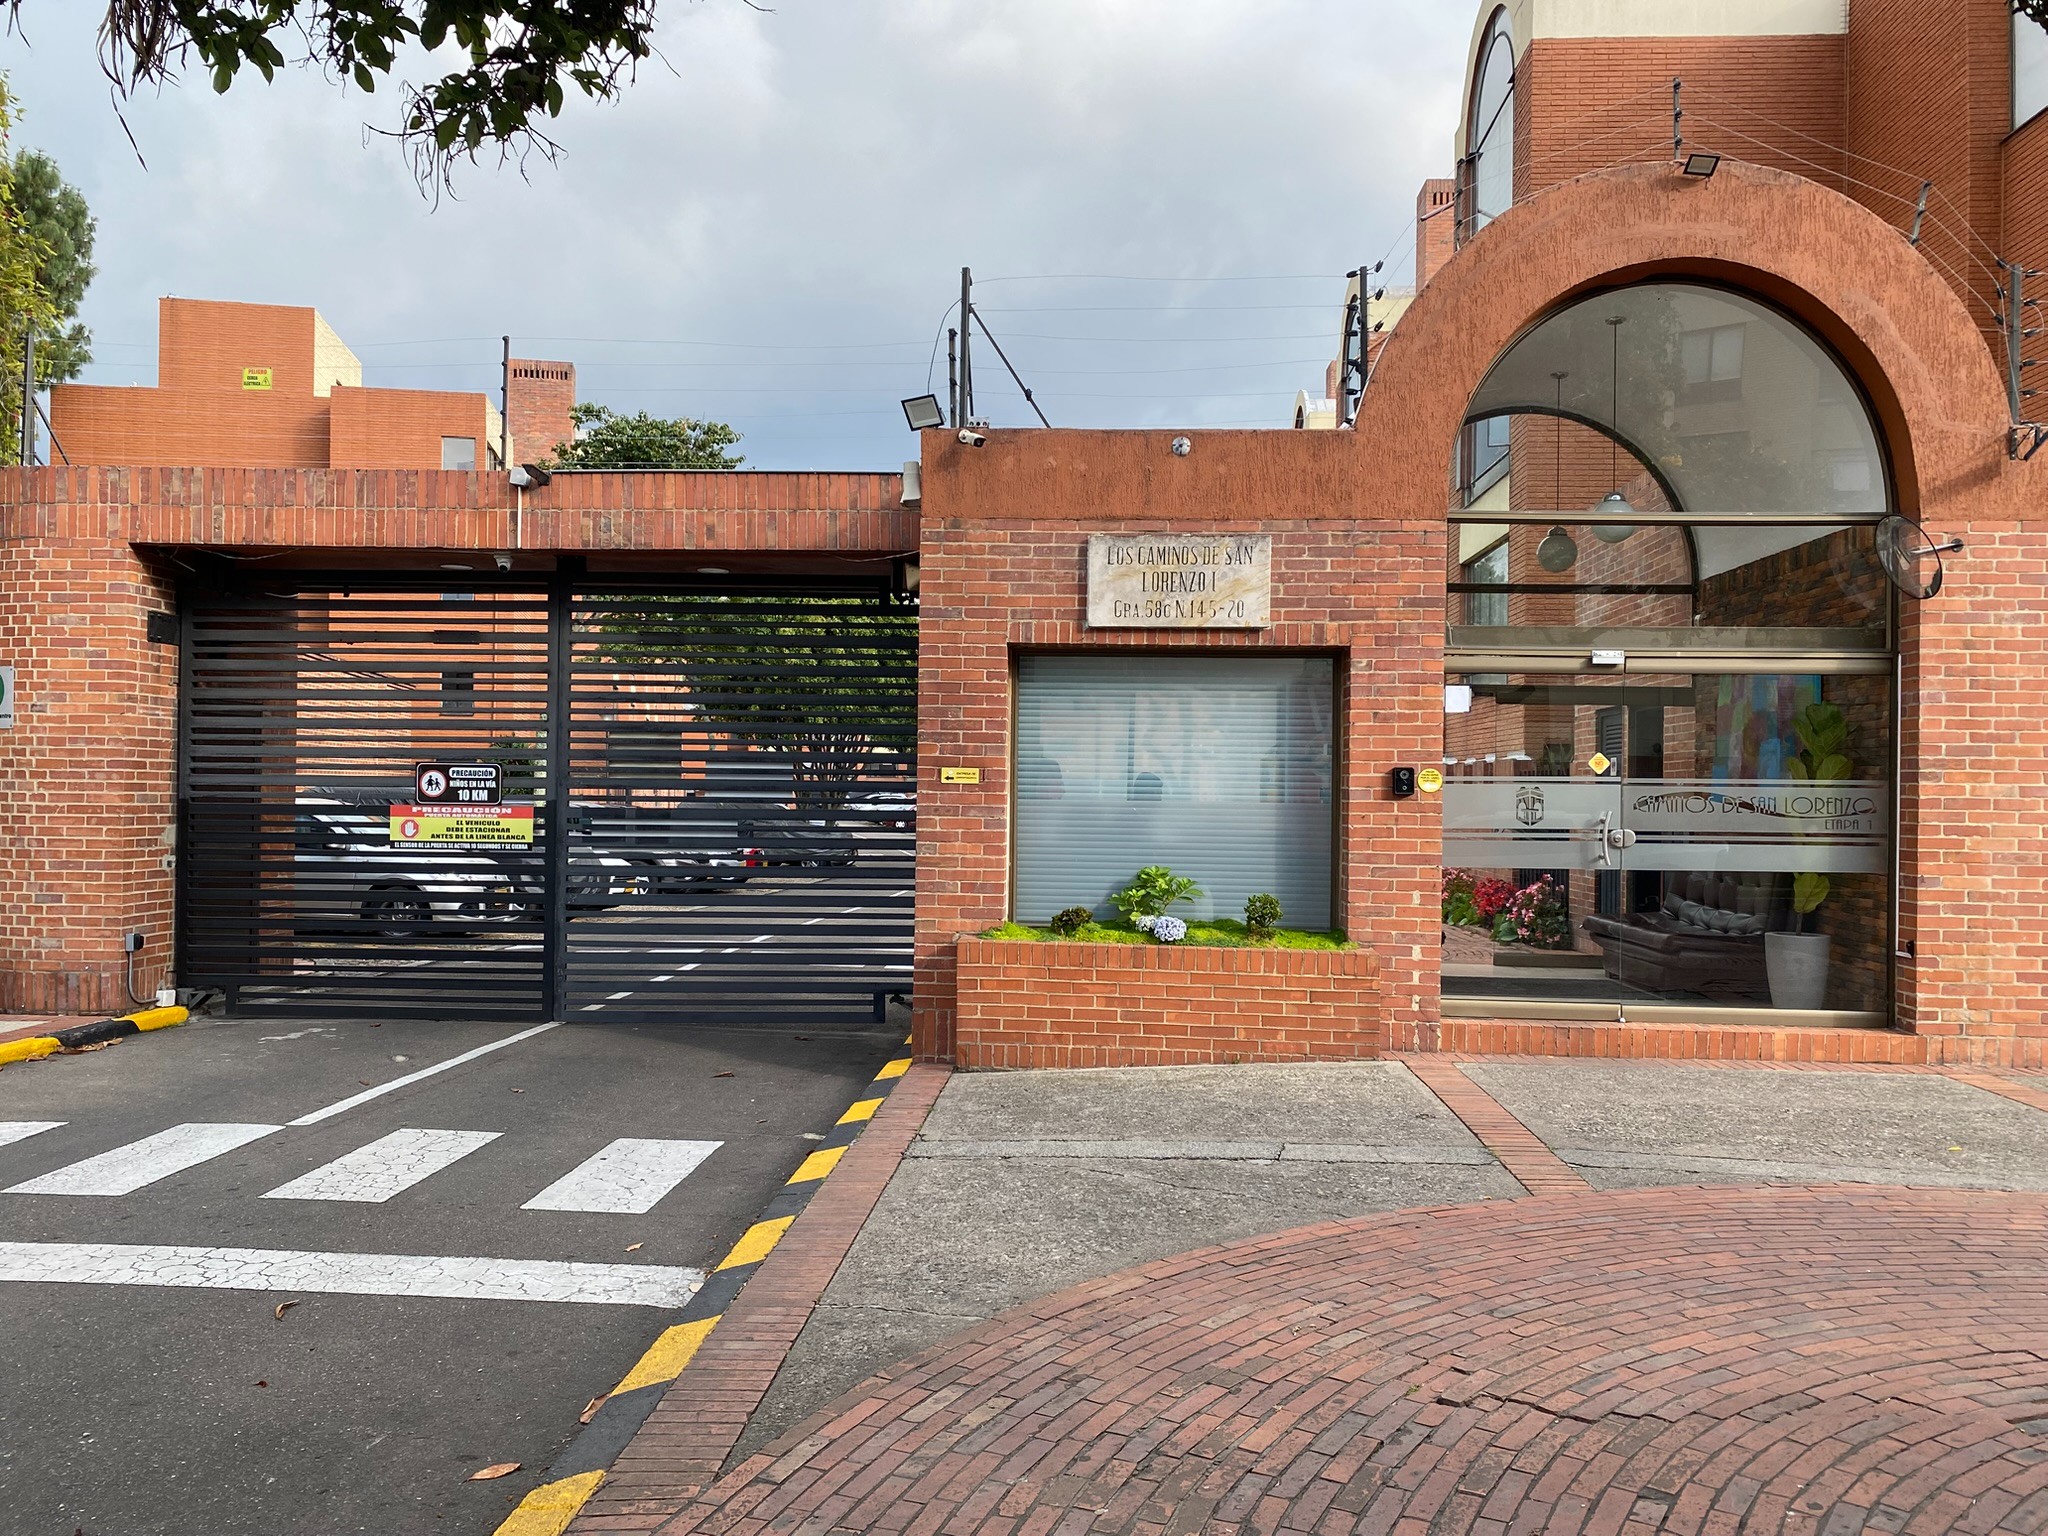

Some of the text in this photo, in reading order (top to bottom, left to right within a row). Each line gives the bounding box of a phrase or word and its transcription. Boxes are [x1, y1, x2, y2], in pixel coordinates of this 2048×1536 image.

[1107, 546, 1253, 565] LOS CAMINOS DE SAN
[1142, 572, 1216, 592] LORENZO I
[450, 779, 468, 788] NIÑOS
[486, 780, 496, 788] VÍA
[458, 790, 488, 800] 10 KM
[1636, 795, 1874, 814] CAMINOS DE SAN LORENZO
[412, 806, 512, 814] PRECAUCIÓN
[1824, 820, 1873, 830] ETAPA 1
